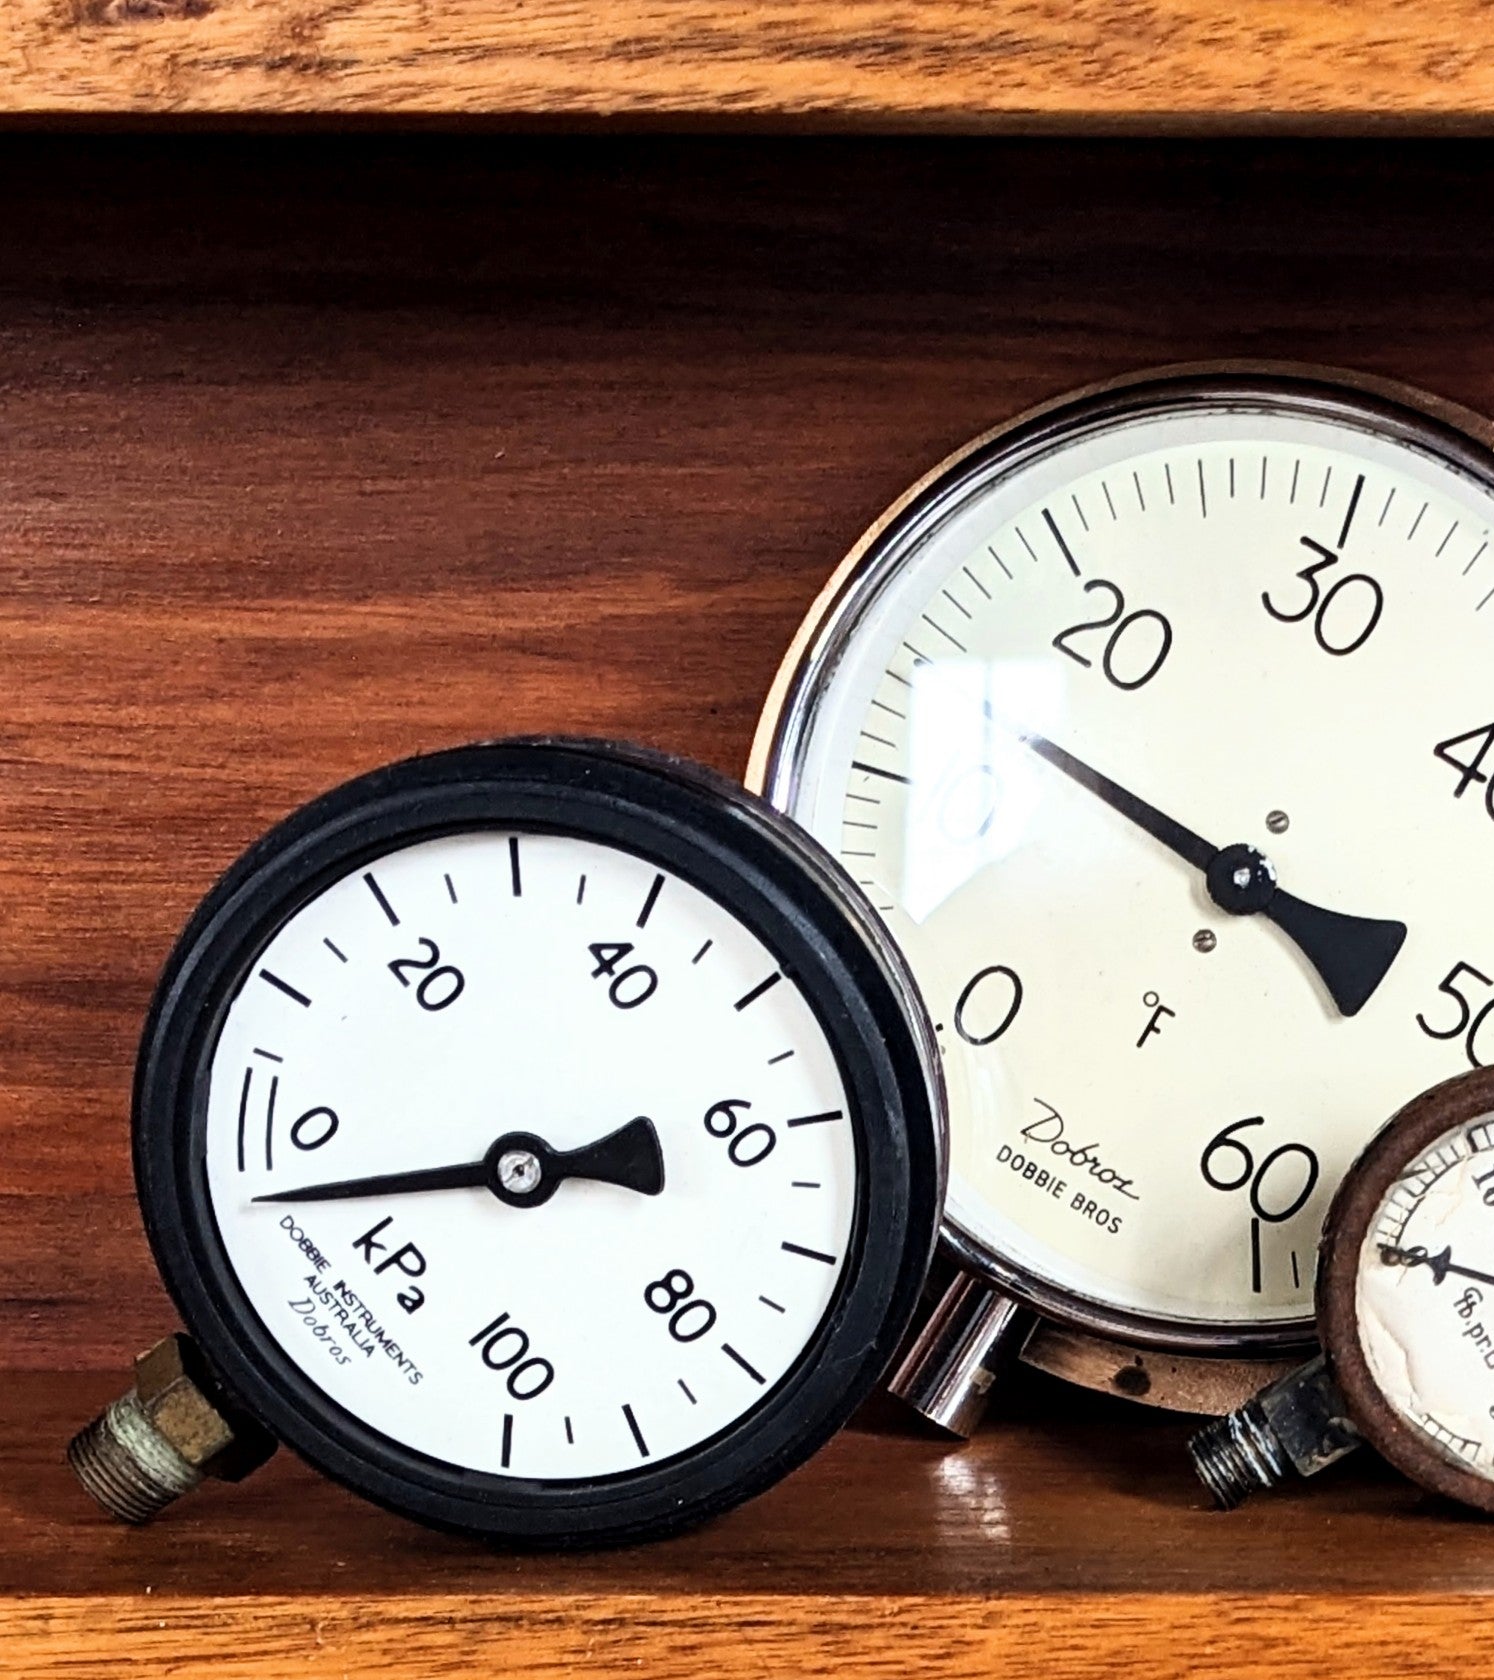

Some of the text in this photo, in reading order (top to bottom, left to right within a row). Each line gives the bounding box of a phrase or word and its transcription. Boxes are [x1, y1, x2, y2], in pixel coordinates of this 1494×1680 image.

[1052, 579, 1173, 690] 20
[1262, 536, 1384, 656] 30
[388, 937, 466, 1012] 20
[587, 939, 660, 1010] 40
[954, 965, 1023, 1046] 0
[290, 1105, 339, 1152] 0
[702, 1098, 778, 1167] 60
[1200, 1116, 1318, 1222] 60
[996, 1145, 1123, 1234] DOBBIE BROS
[279, 1215, 424, 1385] DOBBIE INSTRUMENTS
[352, 1215, 427, 1315] kPa
[643, 1268, 718, 1344] 80
[288, 1297, 351, 1365] Dobros
[303, 1275, 376, 1358] AUSTRALIA
[468, 1312, 555, 1402] 100
